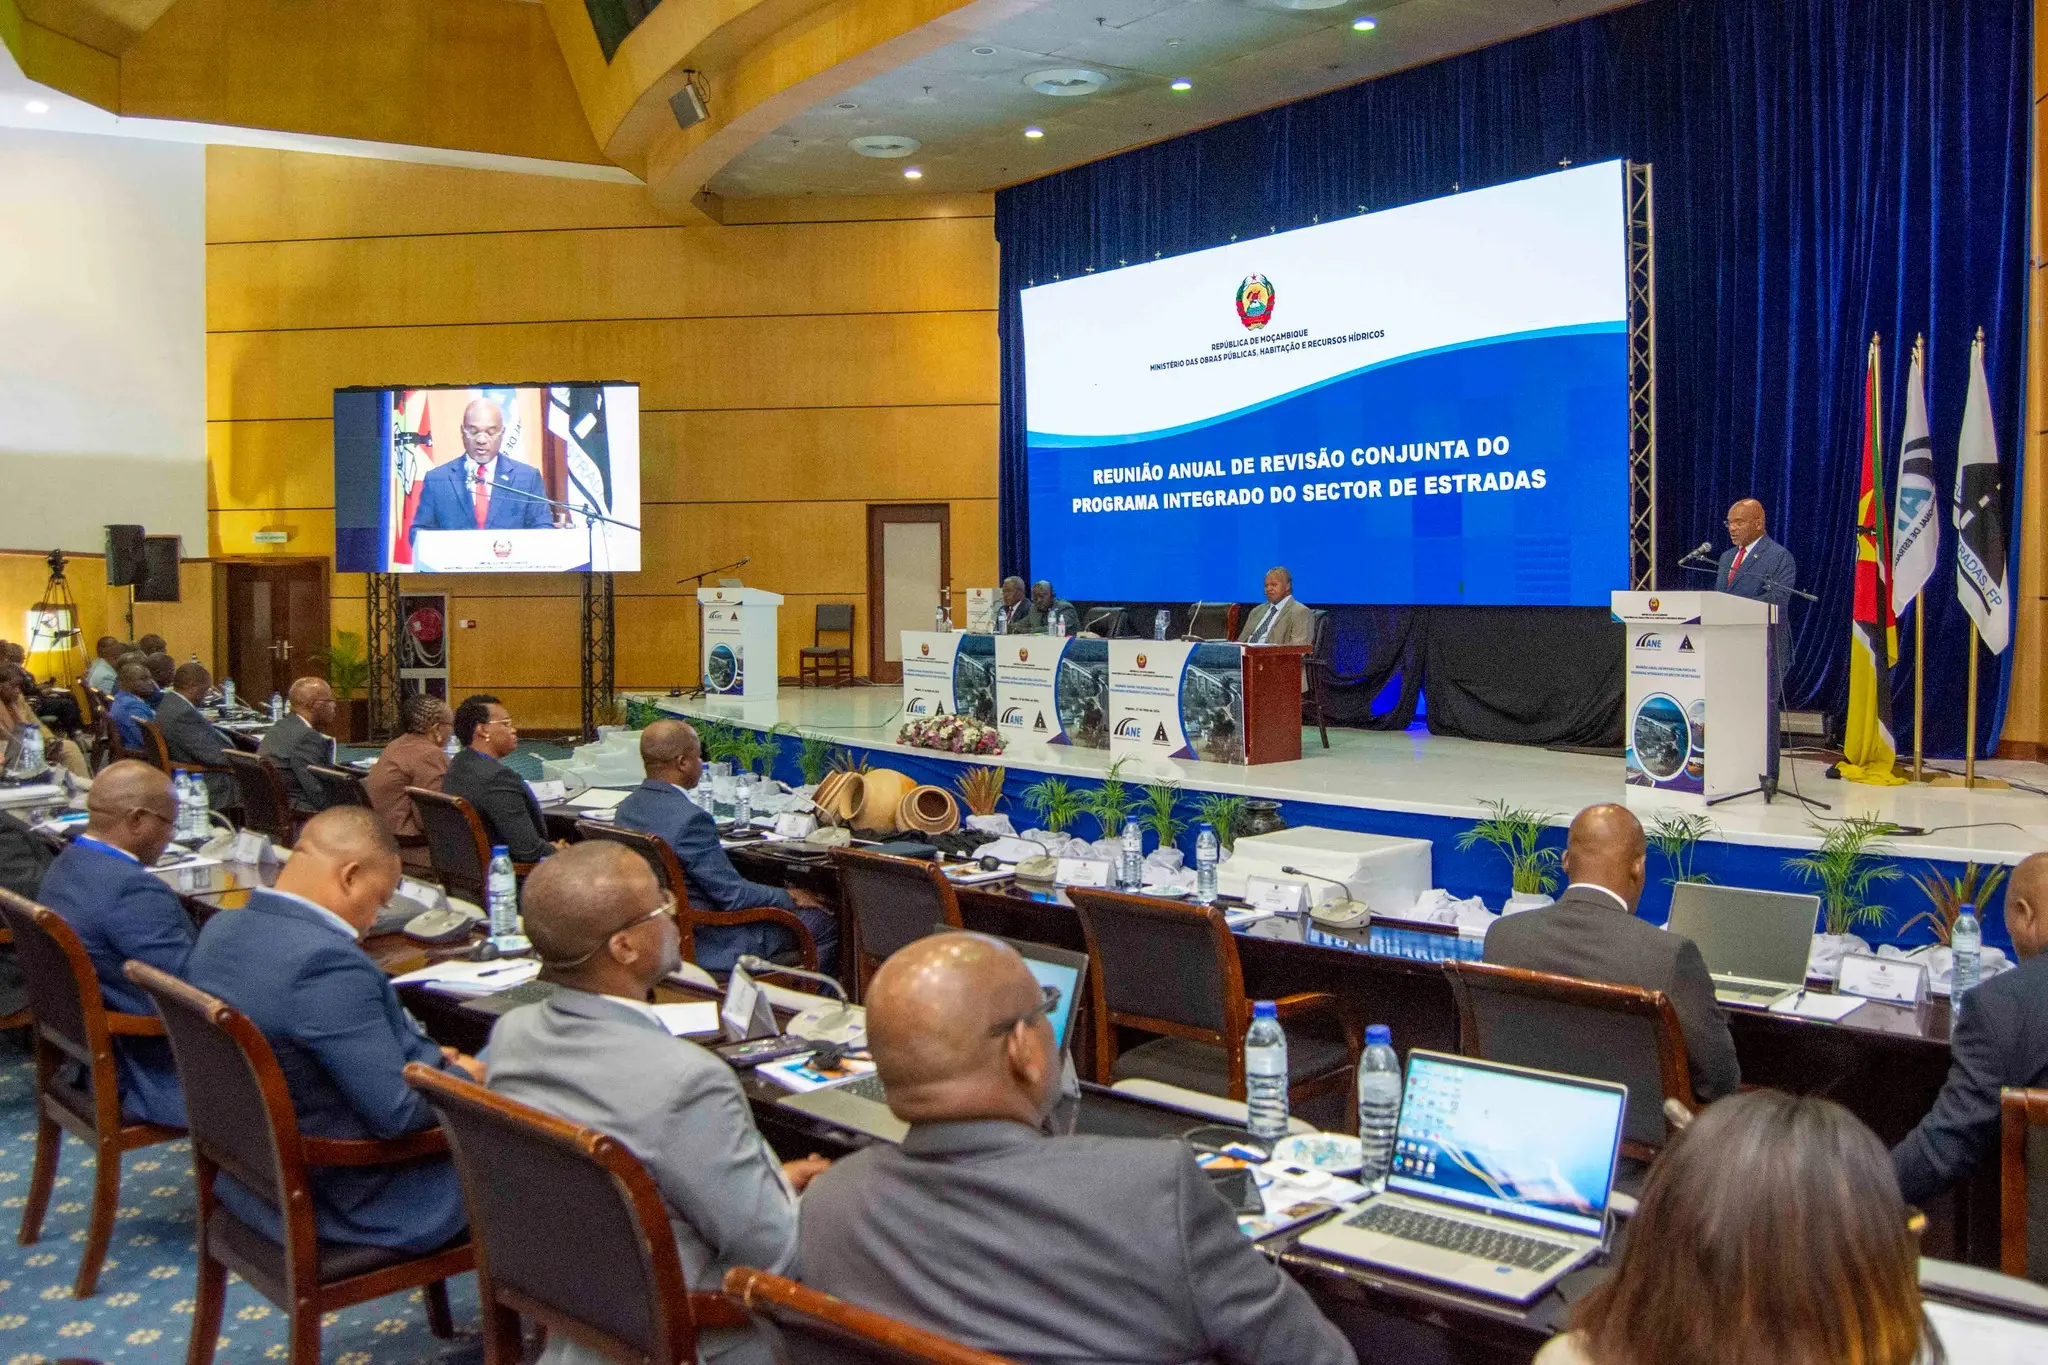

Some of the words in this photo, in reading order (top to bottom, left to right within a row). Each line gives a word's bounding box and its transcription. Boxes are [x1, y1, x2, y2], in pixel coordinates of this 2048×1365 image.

[1150, 358, 1185, 371] MINISTÉRIO
[1185, 357, 1199, 367] DAS
[1199, 354, 1223, 365] OBRAS
[1223, 348, 1259, 361] PÚBLICAS,
[1260, 341, 1301, 356] HABITAÇÃO
[1301, 341, 1307, 349] E
[1307, 335, 1347, 349] RECURSOS
[1348, 329, 1385, 342] HÍDRICOS
[1211, 337, 1249, 351] REPÚBLICA
[1250, 336, 1260, 346] DE
[1260, 328, 1309, 344] MOÇAMBIQUE
[1093, 462, 1164, 485] REUNIÃO
[1168, 460, 1226, 480] ANUAL
[1231, 457, 1255, 475] DE
[1260, 447, 1345, 473] REVISÃO
[1351, 439, 1470, 466] CONJUNTA
[1476, 435, 1510, 457] DO
[1072, 494, 1159, 514] PROGRAMA
[1163, 487, 1264, 509] INTEGRADO
[1270, 485, 1296, 503] DO
[1302, 480, 1382, 502] SECTOR
[1389, 477, 1418, 497] DE
[1424, 468, 1547, 495] ESTRADAS
[1986, 588, 2002, 606] FP
[1646, 640, 1662, 648] ANE
[1125, 726, 1141, 738] ANE
